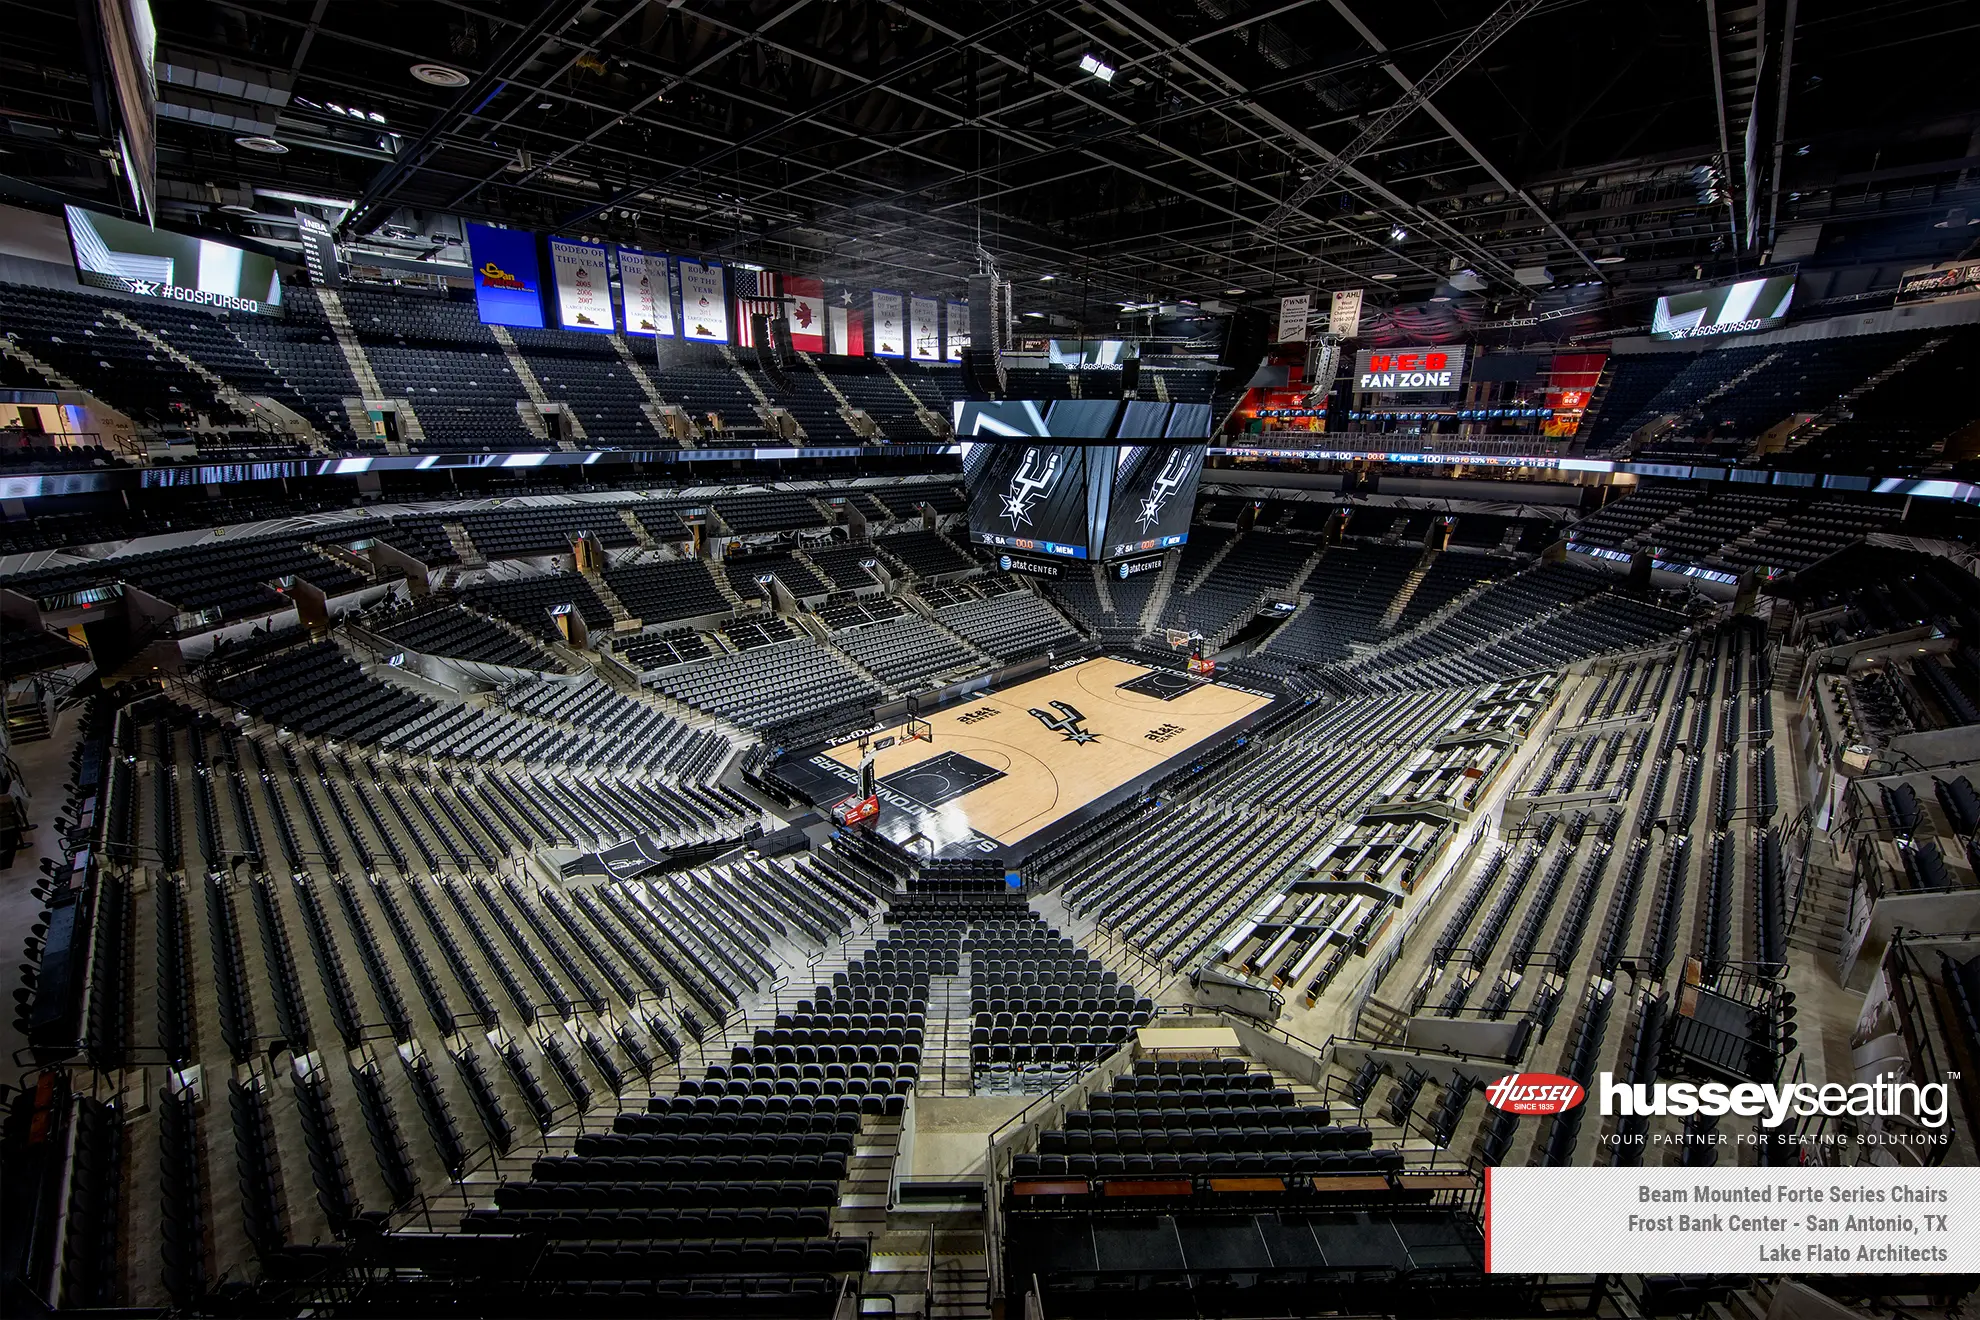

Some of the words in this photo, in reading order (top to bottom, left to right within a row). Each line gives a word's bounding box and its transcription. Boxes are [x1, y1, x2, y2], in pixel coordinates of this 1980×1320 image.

[306, 220, 328, 232] NBA
[554, 243, 588, 256] RODEO
[590, 247, 604, 257] OF
[556, 254, 578, 264] THE
[580, 259, 604, 268] YEAR
[624, 265, 642, 274] THE
[575, 279, 592, 288] 2005
[688, 275, 698, 283] OF
[700, 276, 716, 286] THE
[576, 288, 592, 297] 2006
[693, 285, 713, 294] YEAR
[1346, 291, 1360, 299] AHL
[162, 285, 258, 313] #GOSPURSGO
[578, 297, 593, 305] 2007
[1689, 319, 1761, 337] #GOSPURSGO
[1360, 374, 1395, 388] FAN
[1399, 372, 1452, 387] ZONE
[1335, 452, 1351, 460] 100
[1422, 454, 1440, 464] 100
[995, 536, 1006, 545] SA
[1016, 538, 1034, 549] 00.0
[1056, 546, 1074, 555] MEM
[1125, 544, 1133, 552] SA
[1028, 564, 1058, 576] CENTER
[1141, 560, 1162, 572] CENTER
[1108, 654, 1141, 666] SAN
[1141, 664, 1214, 683] ANTONIO
[1216, 681, 1276, 699] SPURS
[957, 706, 996, 723] at&t
[965, 710, 1001, 725] CENTER
[825, 722, 886, 747] FanDuel
[1144, 723, 1179, 741] at&t
[1156, 727, 1187, 743] CENTER
